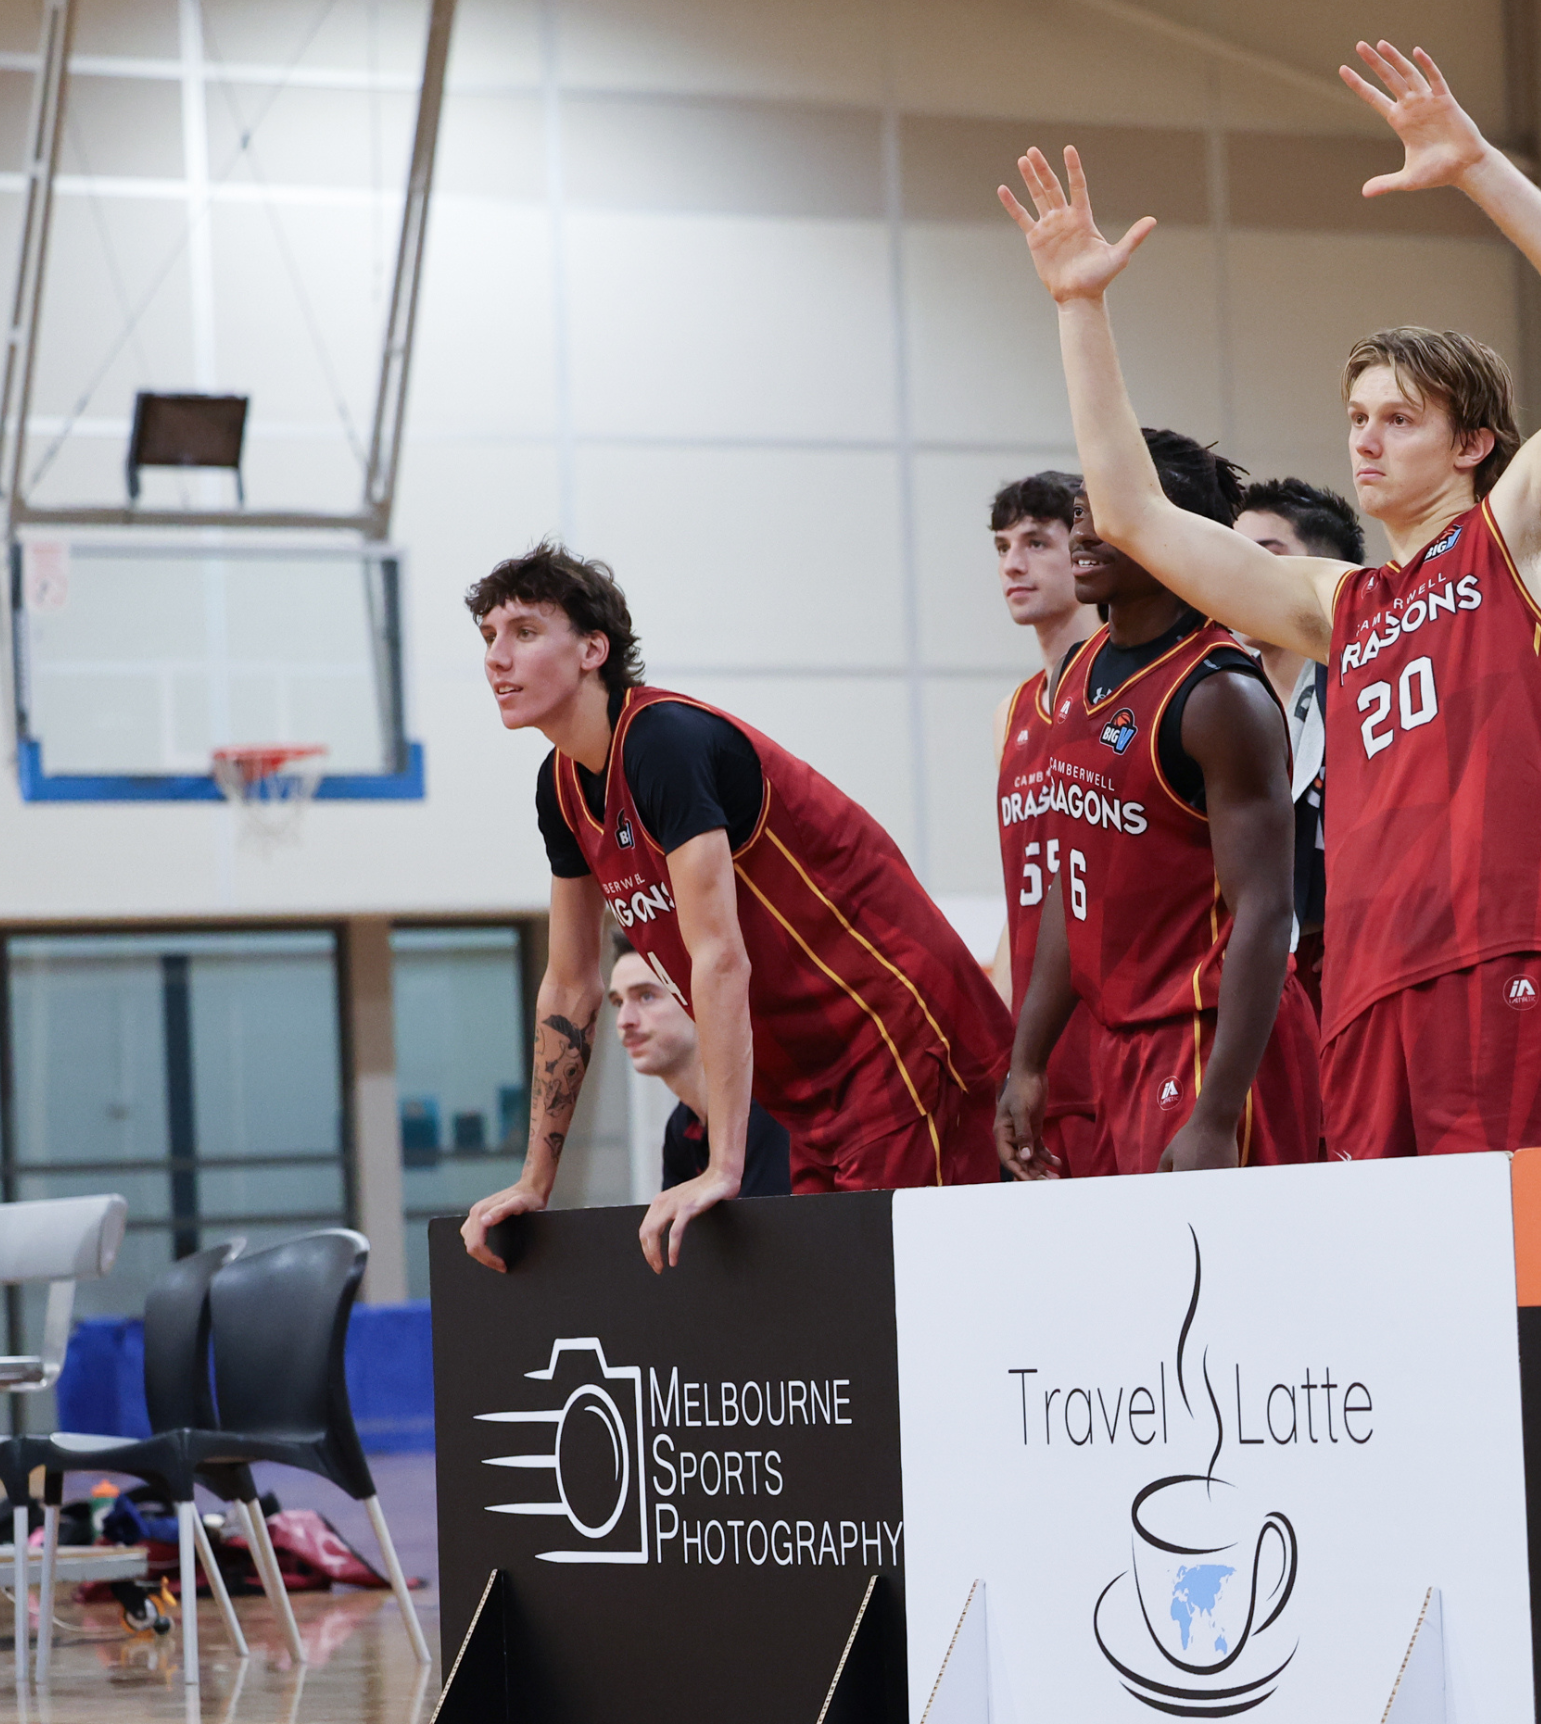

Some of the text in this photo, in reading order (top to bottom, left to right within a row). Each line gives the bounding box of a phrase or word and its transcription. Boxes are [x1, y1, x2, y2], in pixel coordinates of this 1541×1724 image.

[1341, 574, 1482, 680] RAGONS
[1357, 655, 1439, 761] 20
[1069, 848, 1088, 922] 6
[649, 1366, 853, 1428] MELBOURNE
[1008, 1361, 1374, 1446] Travel Latte
[652, 1433, 784, 1497] SPORTS
[655, 1503, 903, 1566] PHOTOGRAPHY
